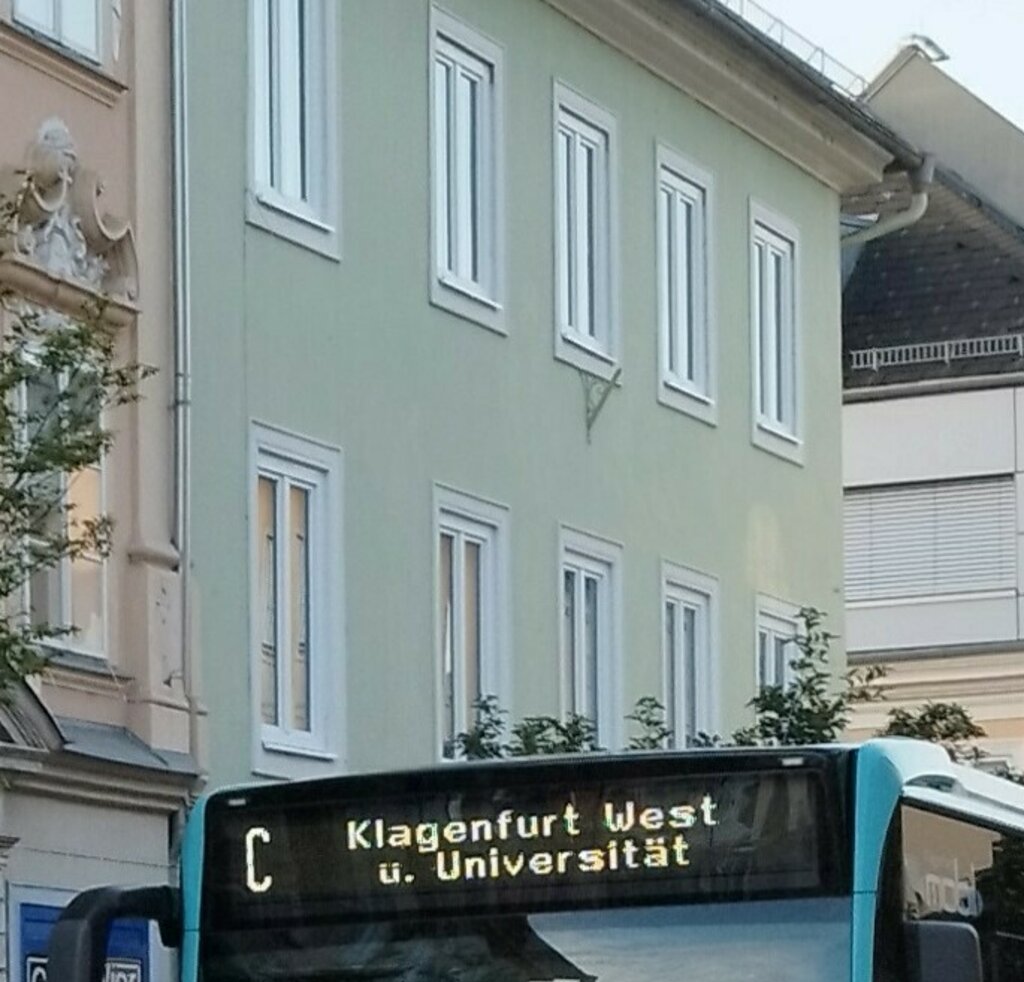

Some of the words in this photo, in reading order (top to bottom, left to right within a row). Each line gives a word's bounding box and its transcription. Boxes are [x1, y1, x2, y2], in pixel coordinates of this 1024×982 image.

[347, 804, 580, 854] Klagenfurt
[604, 795, 720, 833] West
[246, 827, 273, 893] C
[436, 836, 690, 881] Universität
